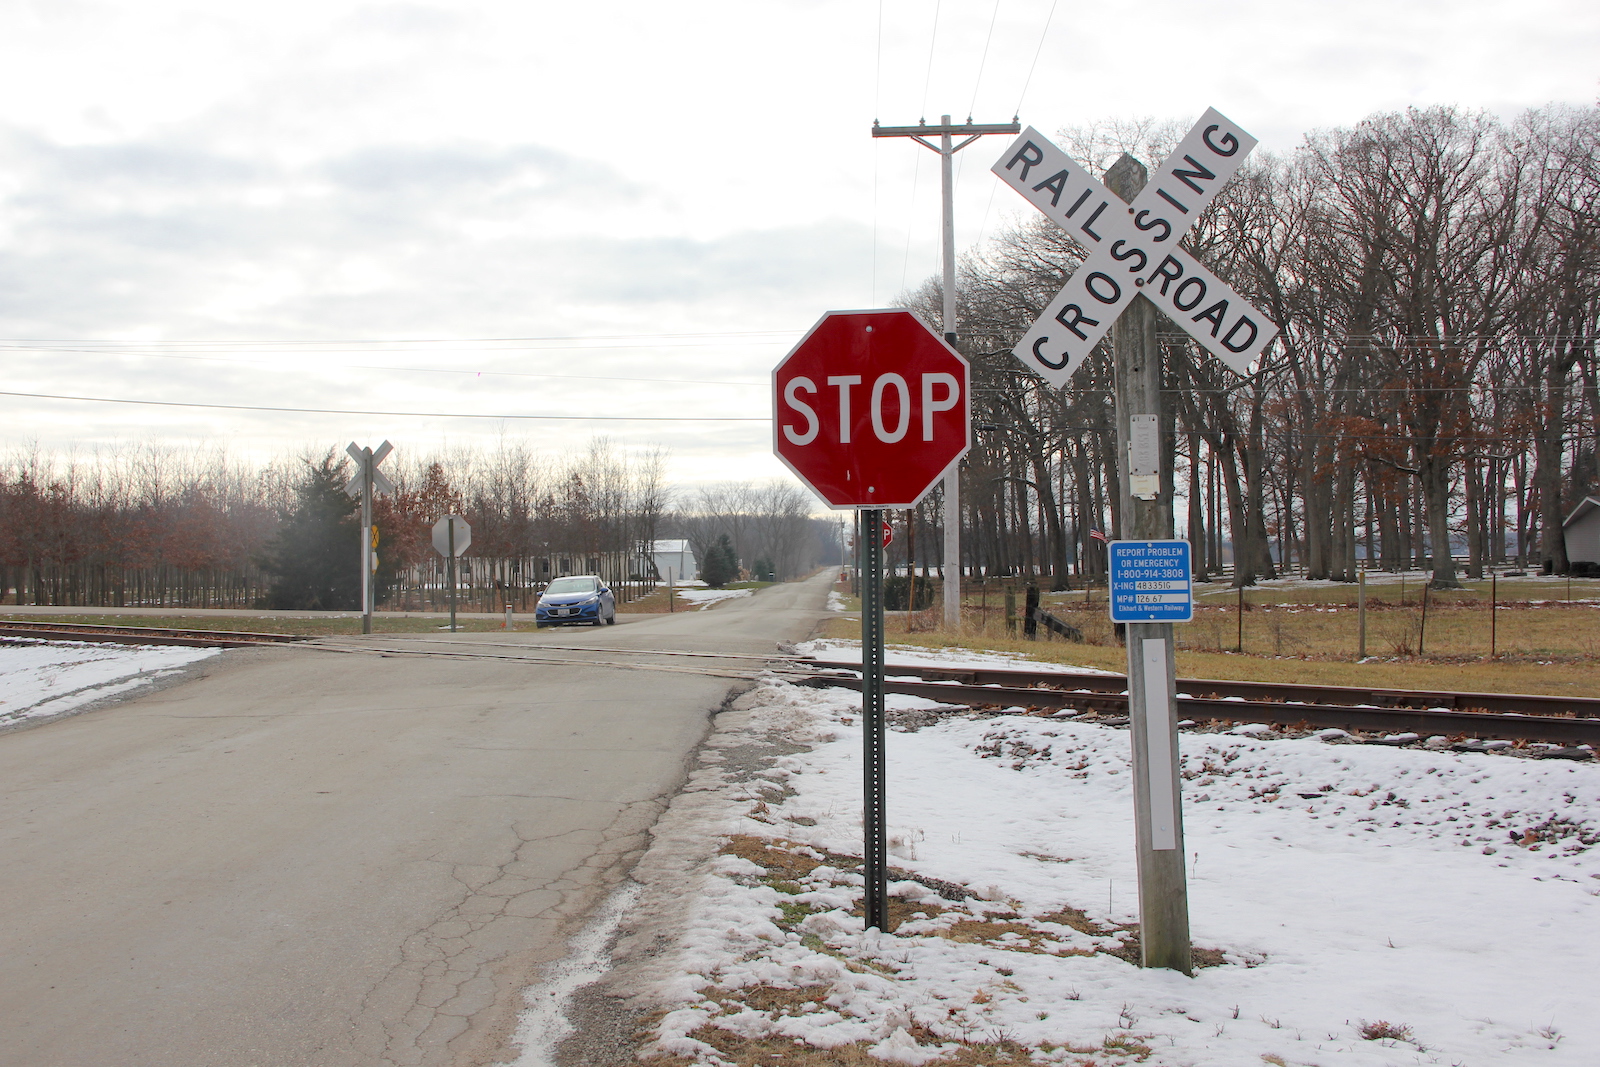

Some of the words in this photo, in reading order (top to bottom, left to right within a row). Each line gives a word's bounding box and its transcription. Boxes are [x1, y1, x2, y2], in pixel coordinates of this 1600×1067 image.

[1005, 140, 1108, 242] RAIL
[1147, 254, 1258, 353] ROAD
[1032, 124, 1239, 370] CROSSING
[783, 372, 960, 446] STOP
[1116, 548, 1145, 557] REPORT
[1147, 547, 1183, 556] PROBLEM
[1121, 559, 1132, 568] OR
[1134, 559, 1179, 567] EMERGENCY
[1117, 568, 1184, 578] 1-800-914-3808
[1113, 581, 1134, 590] X-ING
[1136, 581, 1171, 590] 483351G
[1116, 595, 1134, 603] MP#
[1137, 594, 1163, 603] 126.67
[1118, 604, 1137, 612] Elkhart
[1163, 604, 1184, 612] Railway
